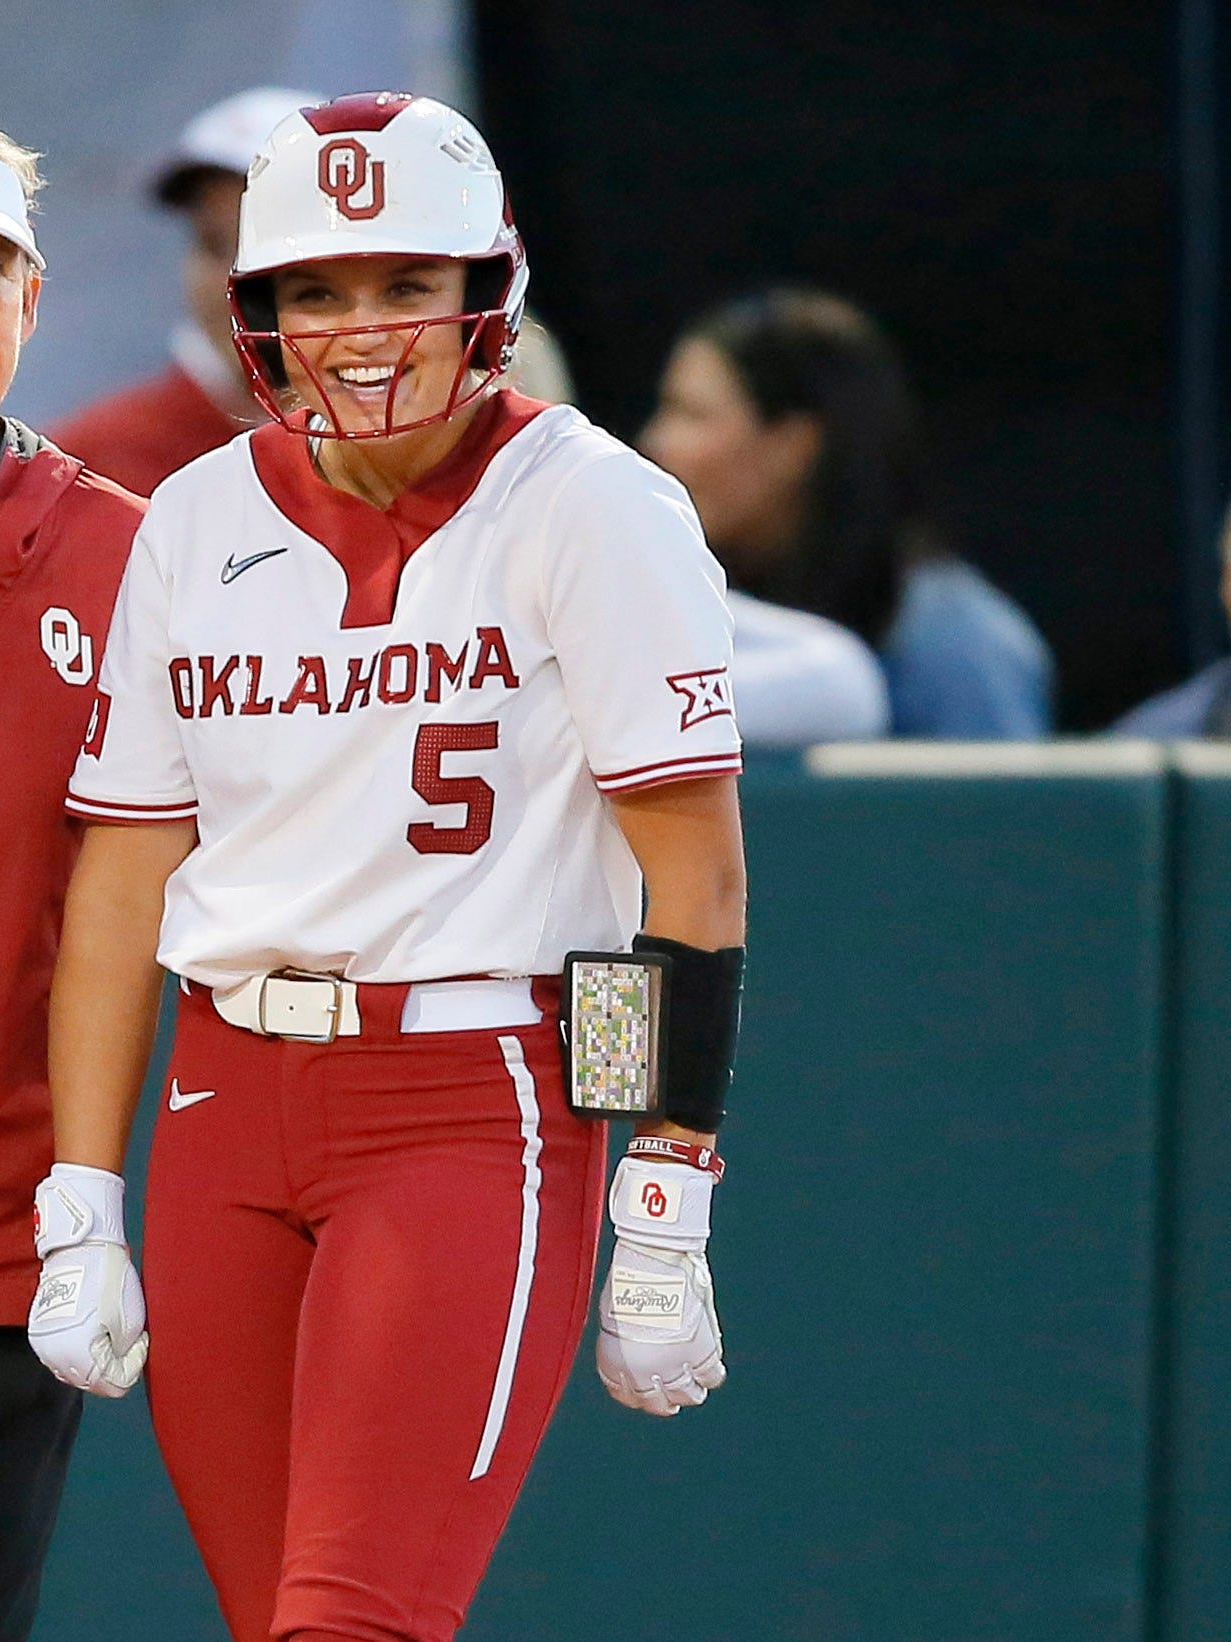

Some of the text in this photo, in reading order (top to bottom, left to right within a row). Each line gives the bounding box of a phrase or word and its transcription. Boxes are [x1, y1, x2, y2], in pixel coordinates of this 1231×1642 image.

[318, 137, 386, 221] OU
[39, 606, 94, 686] OU
[168, 626, 520, 719] OKLAHOMA
[406, 721, 500, 856] 5
[614, 1288, 680, 1313] Rawlings
